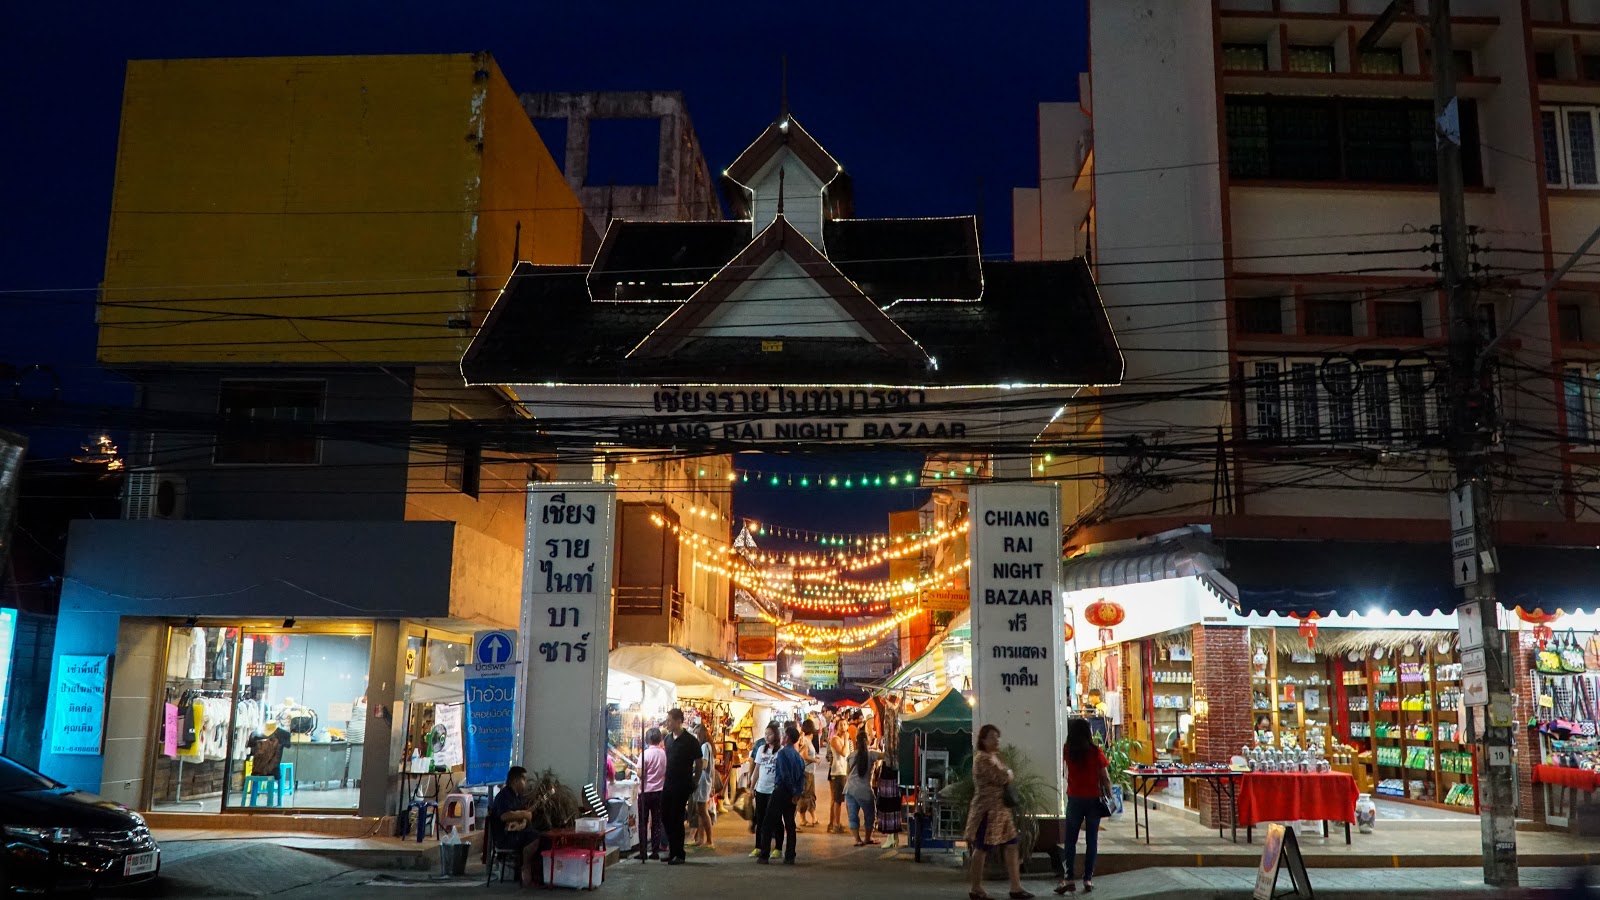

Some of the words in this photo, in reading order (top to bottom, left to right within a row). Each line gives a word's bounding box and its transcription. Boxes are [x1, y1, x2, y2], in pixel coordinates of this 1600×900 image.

[723, 423, 764, 439] RAI
[774, 423, 849, 439] NIGHT
[863, 422, 967, 439] BAZAAR
[542, 493, 595, 525] เชียง
[984, 510, 1050, 527] CHIANG
[545, 538, 590, 559] ราย
[1004, 536, 1033, 553] RAI
[540, 560, 594, 593] ไนท์
[993, 563, 1044, 579] NIGHT
[985, 589, 1053, 606] BAZAAR
[548, 606, 579, 627] บา
[1008, 613, 1027, 632] ฟรี
[538, 632, 590, 663] ซาร์
[992, 645, 1047, 660] การแสดง
[1001, 666, 1038, 693] ทุกคืน
